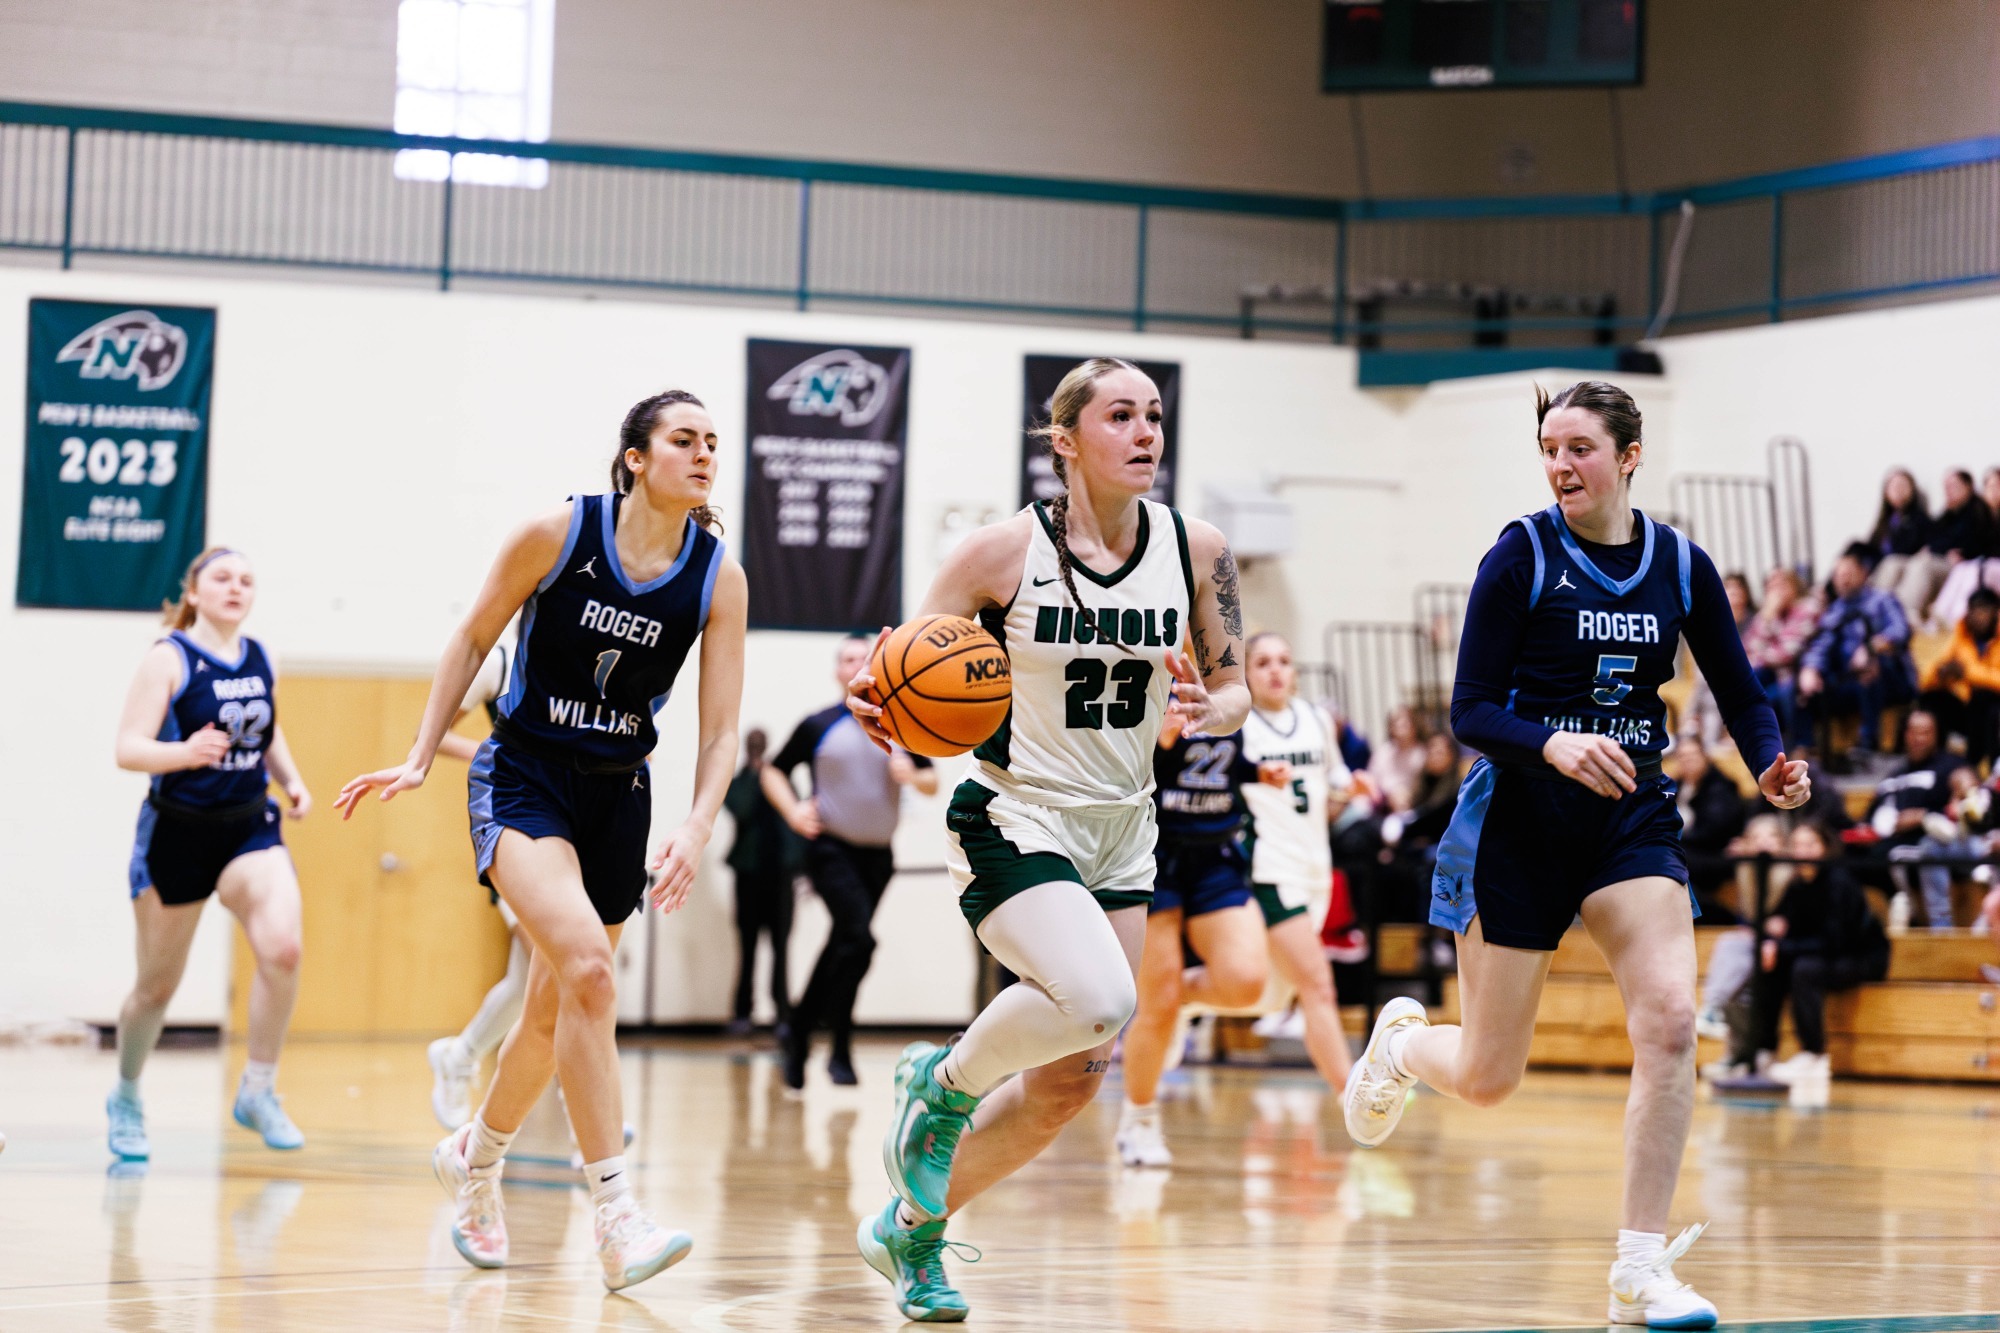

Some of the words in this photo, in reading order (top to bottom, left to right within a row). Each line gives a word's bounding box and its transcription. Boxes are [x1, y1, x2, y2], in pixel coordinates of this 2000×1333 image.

[59, 437, 178, 487] 2023
[580, 599, 663, 647] ROGER
[1034, 605, 1178, 647] NICHOLS
[1578, 610, 1659, 644] ROGER
[594, 648, 622, 700] 1
[965, 657, 1011, 683] NCAA
[1065, 658, 1154, 730] 23
[1591, 654, 1638, 705] 5
[549, 696, 642, 736] WILLIAS
[1177, 740, 1237, 790] 22
[1292, 778, 1309, 813] 5
